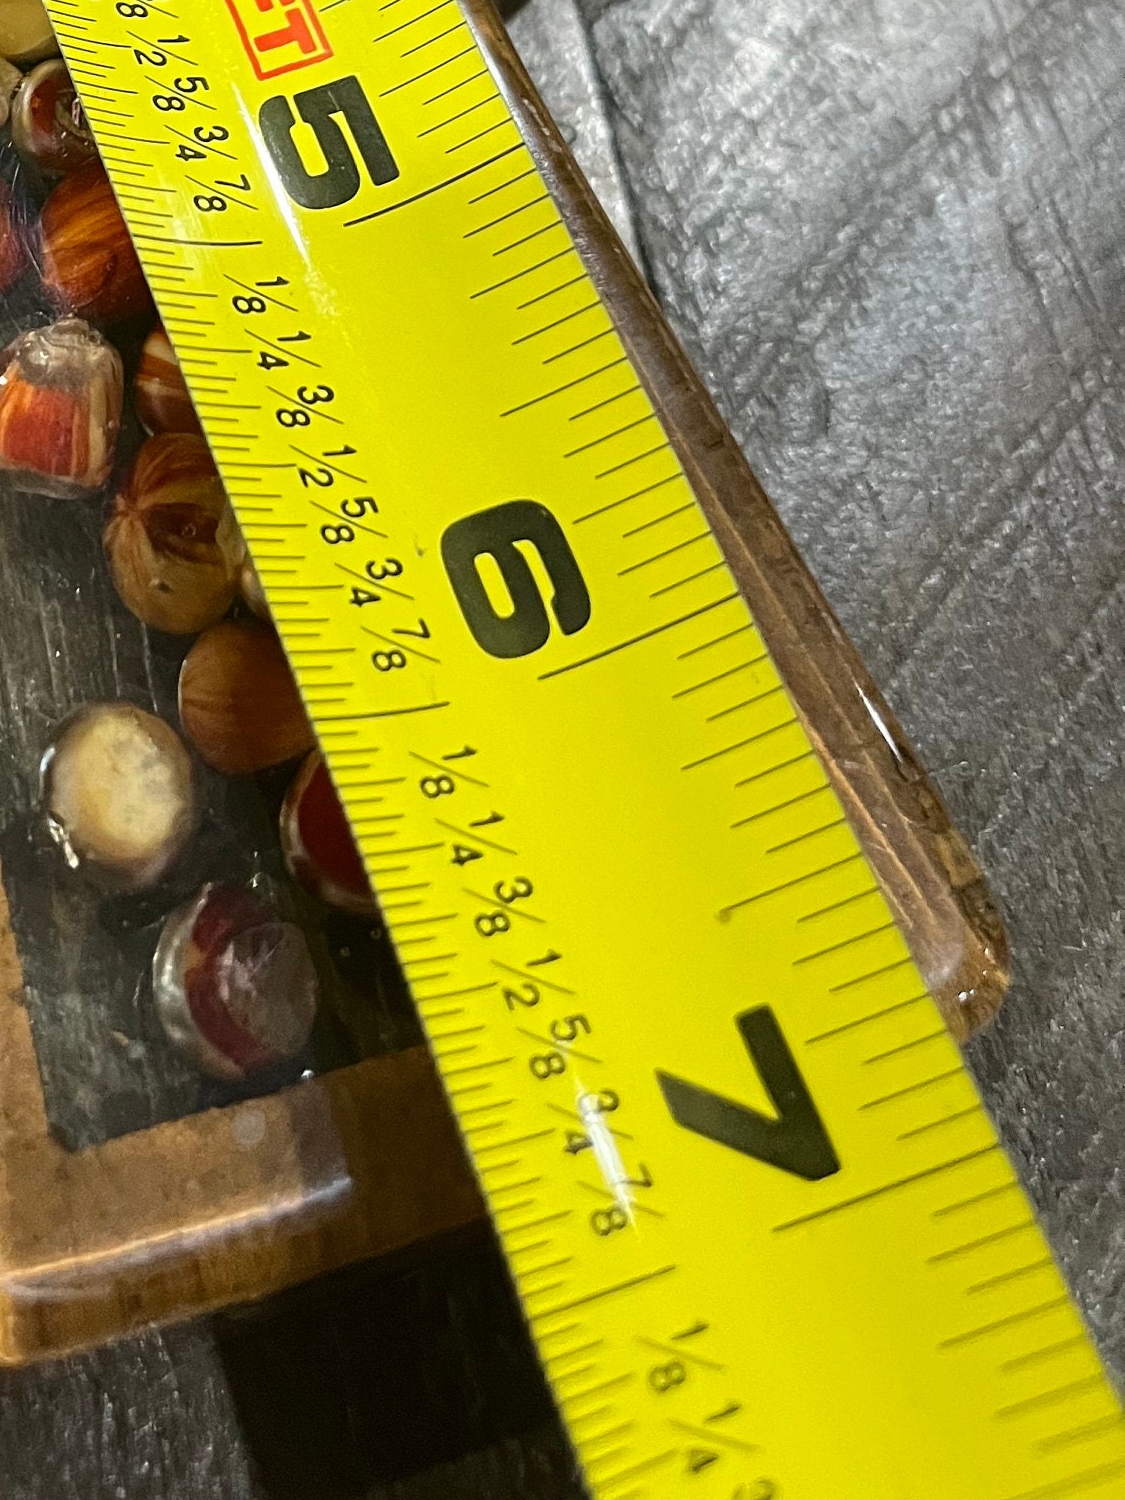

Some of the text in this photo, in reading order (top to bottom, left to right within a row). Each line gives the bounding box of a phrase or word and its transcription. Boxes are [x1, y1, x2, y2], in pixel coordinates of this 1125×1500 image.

[258, 75, 401, 209] 5
[440, 499, 592, 659] 6
[654, 1002, 841, 1182] 7
